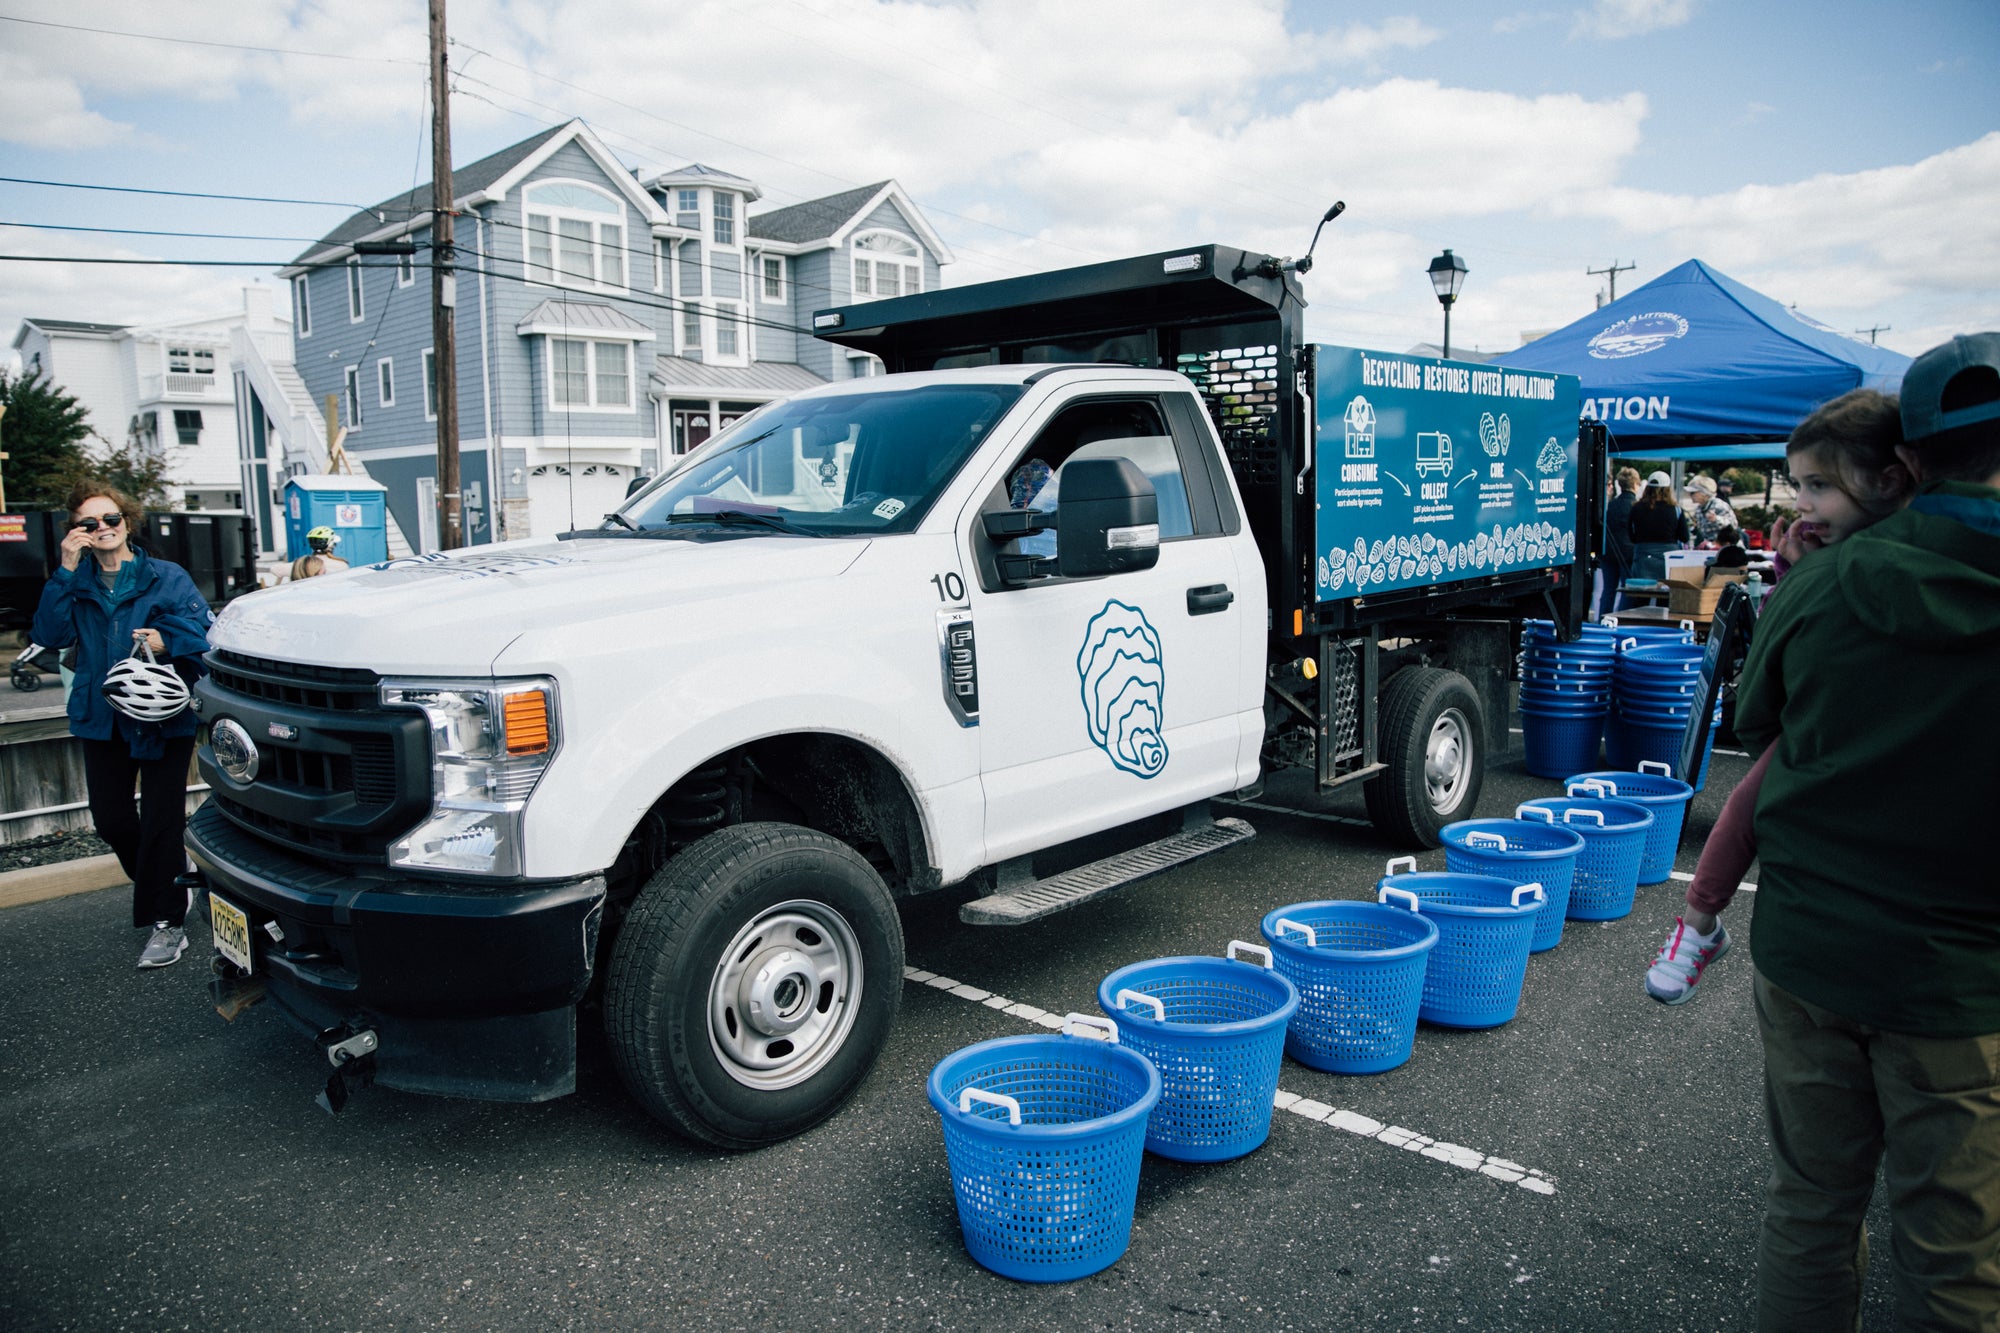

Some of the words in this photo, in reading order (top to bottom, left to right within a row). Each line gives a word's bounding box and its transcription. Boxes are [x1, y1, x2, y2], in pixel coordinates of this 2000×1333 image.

[1362, 357, 1421, 391] RECYCLING
[1424, 364, 1469, 394] RESTORES
[1472, 370, 1502, 397] OYSTER
[1504, 374, 1555, 401] POPULATIONS
[1341, 463, 1378, 482] CONSUME
[1490, 461, 1504, 478] CURE
[1421, 482, 1448, 500] COLLECT
[1540, 478, 1565, 493] CULTIVATE
[878, 503, 890, 512] 11
[887, 506, 899, 515] 25
[930, 571, 965, 602] 10
[951, 630, 975, 696] F350
[214, 909, 248, 957] 42258MG
